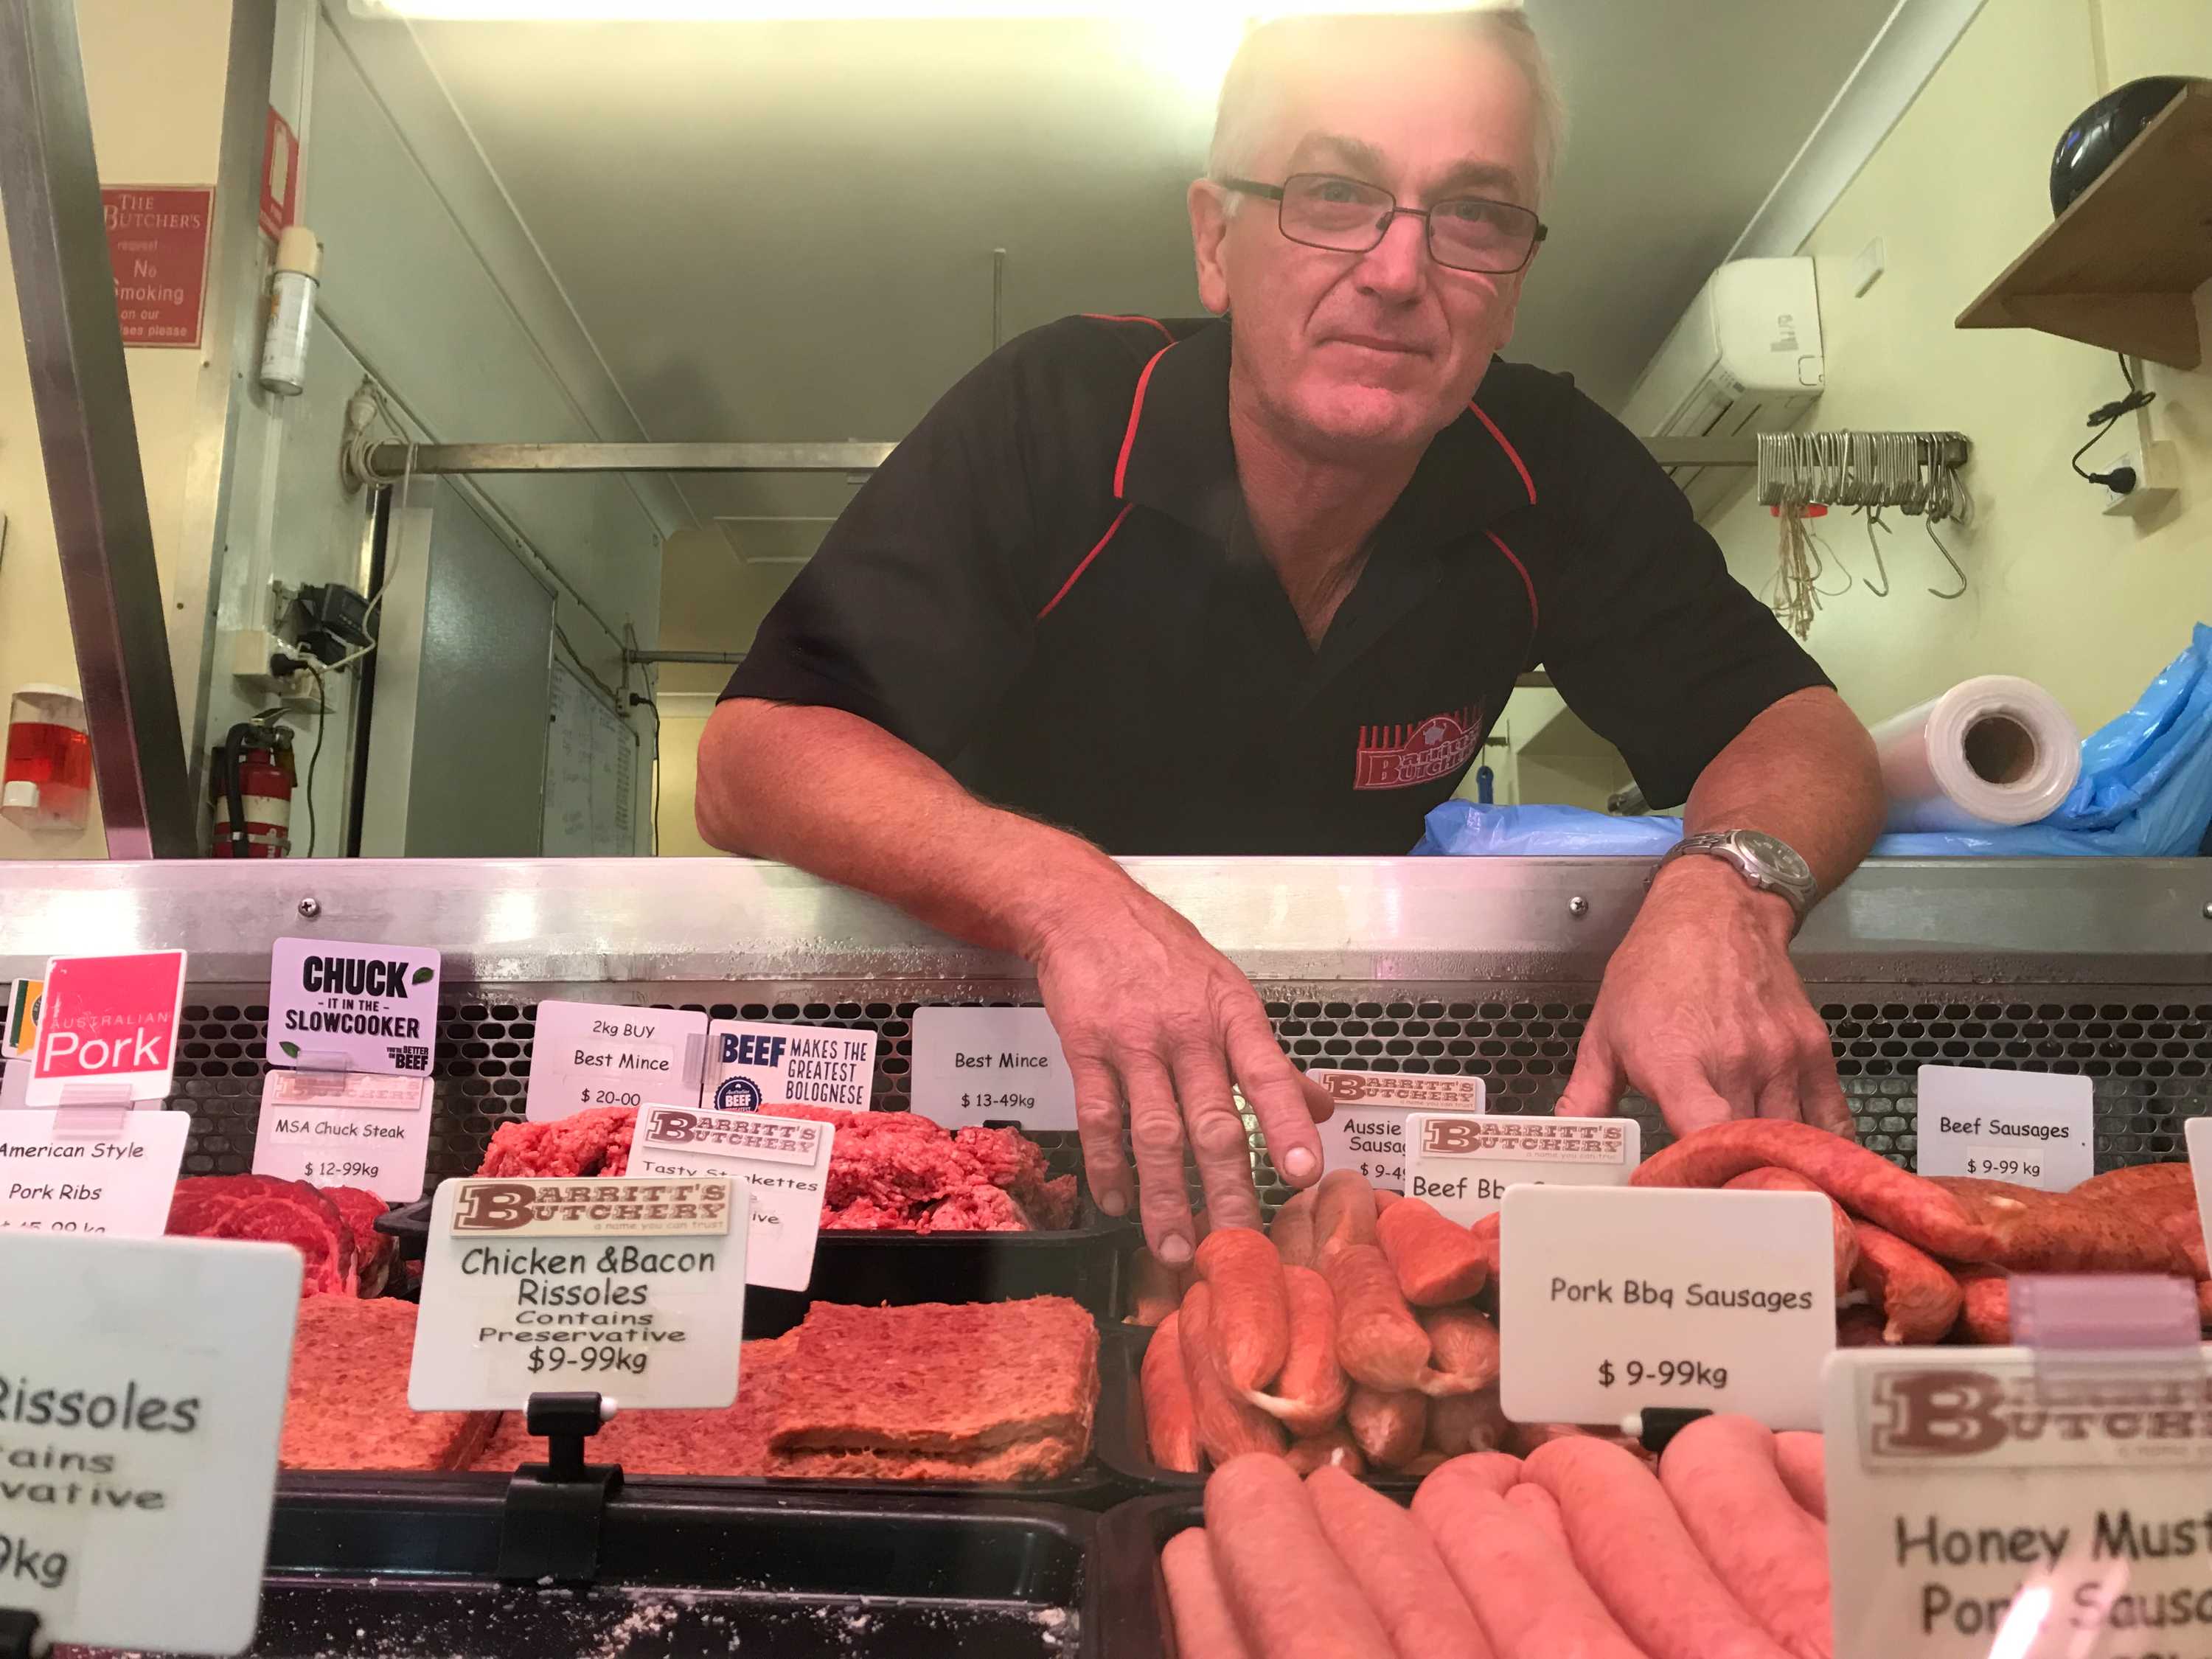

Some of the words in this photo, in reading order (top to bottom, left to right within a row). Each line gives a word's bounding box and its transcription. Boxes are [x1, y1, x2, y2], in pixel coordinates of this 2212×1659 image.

[119, 194, 154, 210] THE
[133, 259, 157, 278] No
[114, 277, 184, 305] moking
[120, 309, 136, 320] on
[140, 309, 160, 320] our
[147, 324, 187, 337] please
[303, 956, 408, 998] CHUCK
[328, 998, 338, 1009] IT
[343, 999, 354, 1010] IN
[359, 1000, 379, 1012] THE
[50, 1012, 169, 1029] AUSTRALIAN
[285, 1009, 420, 1038] SLOWCOOKER
[593, 1020, 618, 1037] 2kg
[623, 1023, 655, 1039] BUY
[43, 1028, 161, 1072] Pork
[720, 1033, 787, 1068] BEEF
[790, 1038, 838, 1060] MAKES
[844, 1042, 867, 1061] THE
[395, 1054, 428, 1071] BEEF
[574, 1050, 613, 1067] Best
[618, 1054, 669, 1071] Mince
[956, 1053, 992, 1068] Best
[999, 1053, 1048, 1068] Mince
[788, 1060, 857, 1082] GREATEST
[581, 1090, 590, 1104] $
[596, 1091, 641, 1106] 20-00
[726, 1094, 751, 1107] BEEF
[786, 1080, 863, 1105] BOLOGNESE
[961, 1093, 970, 1107] $
[977, 1094, 1034, 1108] 13-49kg
[275, 1119, 309, 1133] MSA
[315, 1121, 358, 1136] Chuck
[363, 1124, 405, 1138] Steak
[1343, 1119, 1401, 1135] Aussie
[1940, 1117, 1981, 1135] Beef
[1989, 1119, 2070, 1140] Sausages
[0, 1143, 85, 1158] American
[91, 1142, 144, 1159] Style
[305, 1162, 313, 1176] $
[319, 1162, 378, 1178] 12-99kg
[644, 1161, 697, 1177] Tasty
[1360, 1163, 1368, 1176] $
[1967, 1159, 1976, 1173] $
[1983, 1160, 2018, 1175] 9-99
[2023, 1161, 2040, 1177] kg
[8, 1183, 54, 1200] Pork
[59, 1183, 102, 1200] Ribs
[1413, 1176, 1467, 1199] Beef
[1478, 1179, 1506, 1199] Bb
[594, 1222, 602, 1231] a
[641, 1222, 664, 1231] you
[667, 1222, 689, 1230] can
[692, 1220, 724, 1229] trust
[462, 1247, 585, 1275] Chicken
[597, 1246, 714, 1273] &Bacon
[518, 1278, 647, 1306] Rissoles
[1551, 1277, 1613, 1303] Pork
[1624, 1280, 1673, 1309] Bbq
[1686, 1284, 1812, 1312] Sausages
[515, 1310, 653, 1326] Contains
[479, 1326, 686, 1343] Preservative
[528, 1346, 647, 1374] $9-99kg
[1599, 1360, 1615, 1388] $
[1627, 1360, 1728, 1388] 9-99kg
[0, 1445, 114, 1474] ains
[1894, 1514, 2070, 1572] Honey
[1921, 1583, 2023, 1635] Por
